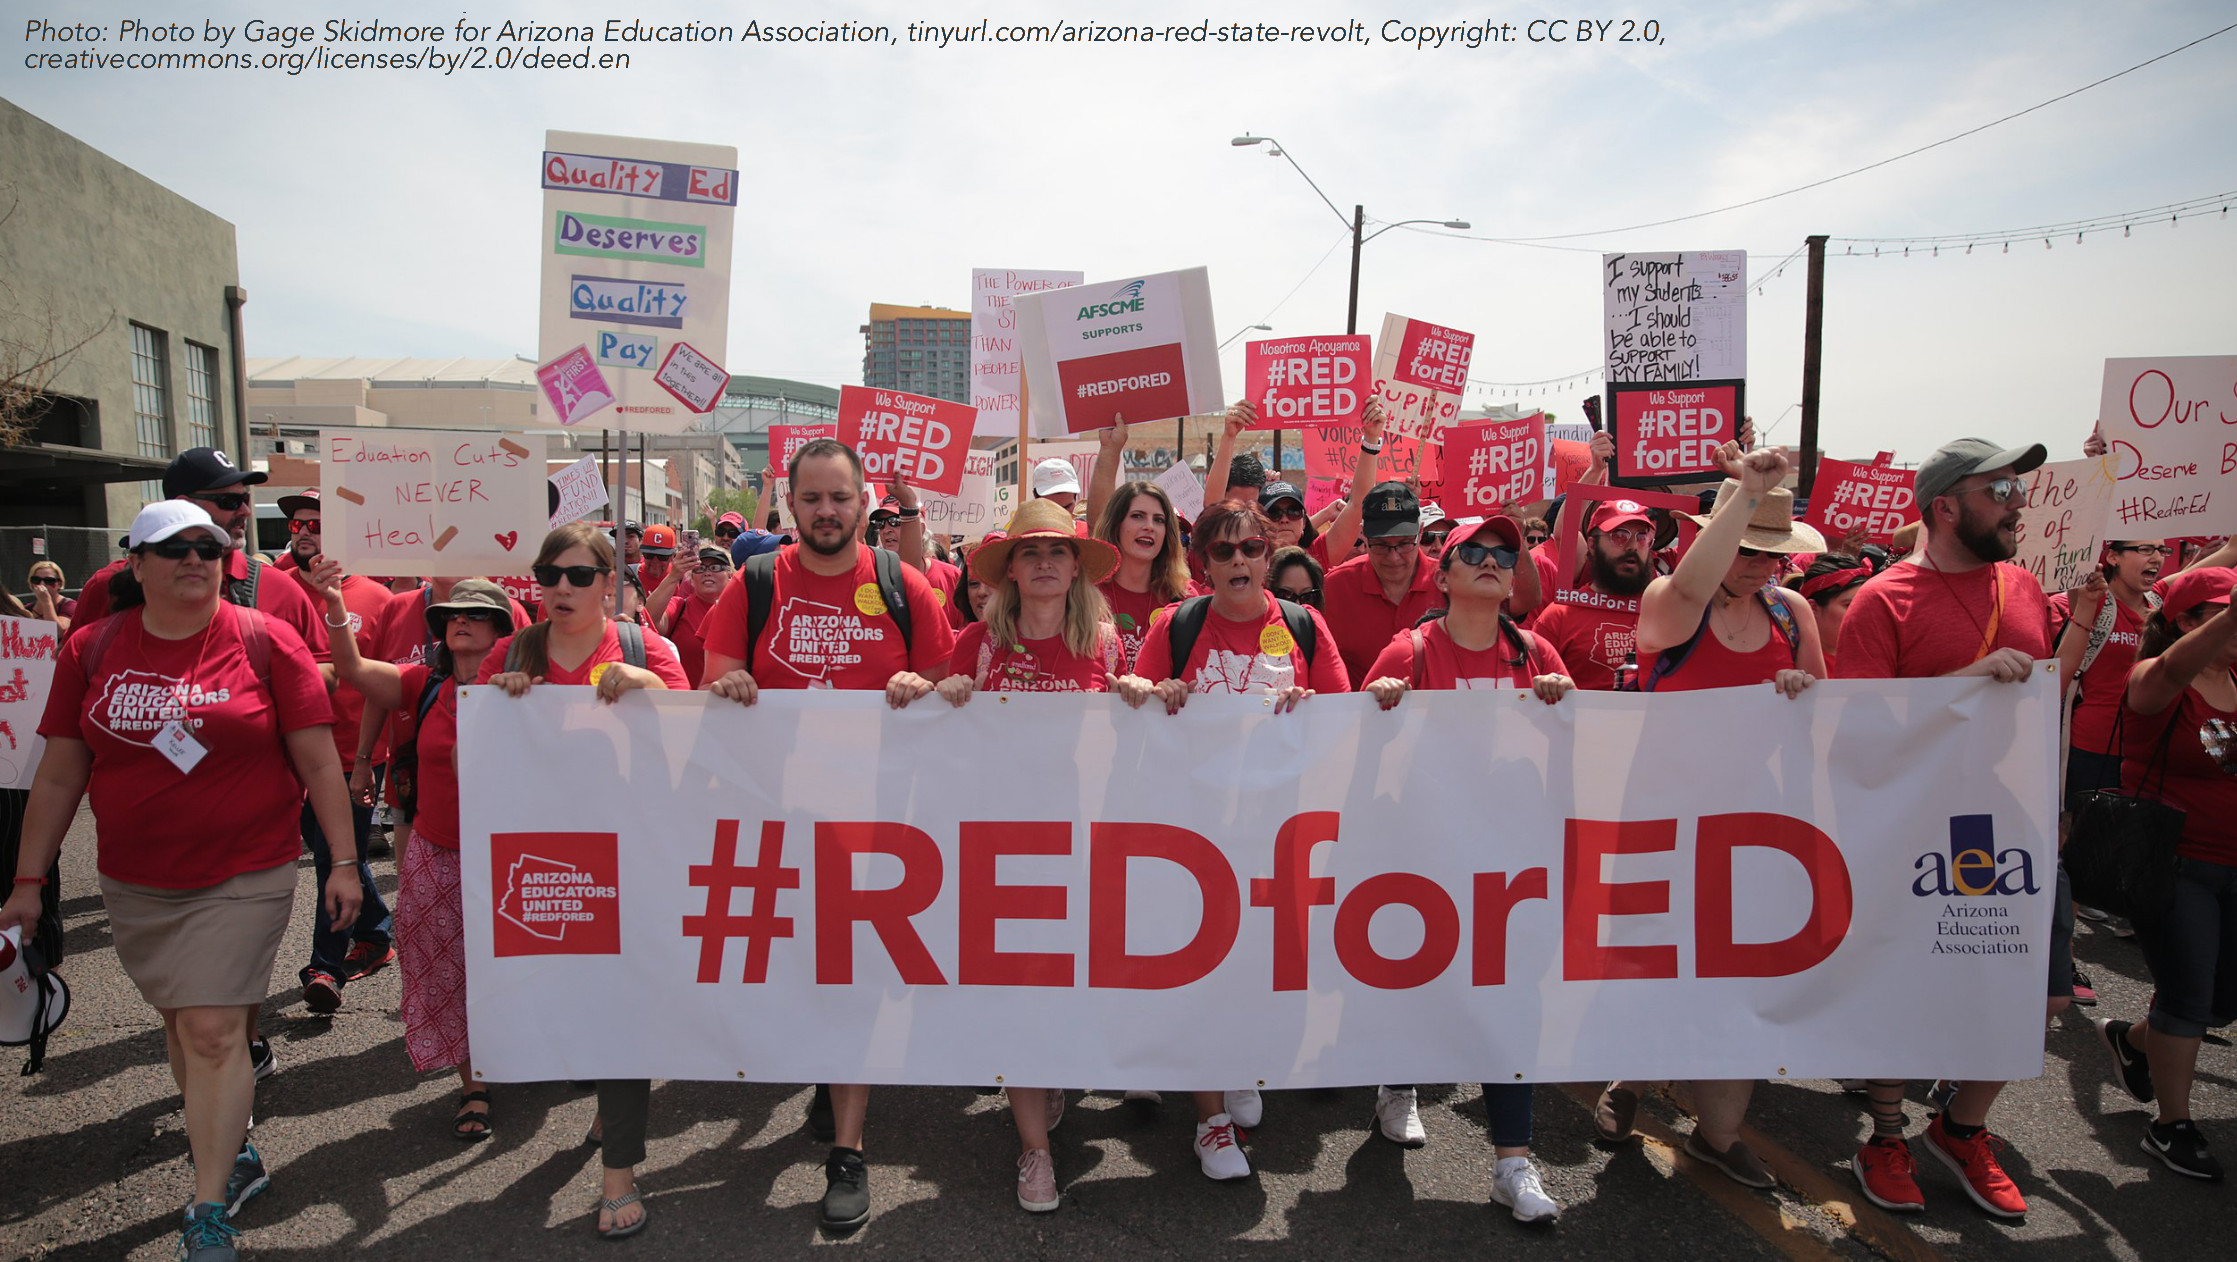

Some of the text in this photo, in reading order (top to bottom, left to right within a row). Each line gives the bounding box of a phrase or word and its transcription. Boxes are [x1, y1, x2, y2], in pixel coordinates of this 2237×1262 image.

[546, 156, 730, 201] Quality Ed
[560, 214, 698, 256] Deserves
[1608, 253, 1684, 287] I support
[572, 283, 688, 318] Quality
[1617, 284, 1640, 308] my
[1077, 298, 1145, 321] AFSCME
[1647, 306, 1691, 330] should
[971, 334, 1012, 352] THAN
[1082, 323, 1143, 340] SUPPORTS
[1431, 326, 1469, 344] We Support
[1611, 329, 1697, 349] be able to
[599, 332, 654, 367] Pay
[1260, 338, 1361, 357] Nosotros Apoyamos
[1417, 337, 1472, 367] #RED
[1609, 350, 1676, 368] SUPPORT
[974, 362, 1019, 376] PEOPLE
[1267, 356, 1357, 387] #RED
[1410, 356, 1467, 387] forED
[1613, 365, 1642, 382] MY
[1077, 371, 1172, 398] #REDFORED
[875, 392, 936, 415] We Support
[975, 394, 1020, 412] POWER
[1262, 387, 1358, 418] forED
[1649, 391, 1705, 408] We Support
[2129, 369, 2209, 429] Our
[859, 410, 951, 451] #RED
[1481, 423, 1530, 442] We Support
[1638, 408, 1724, 438] #RED
[331, 438, 519, 468] Education Cuts
[856, 440, 945, 481] forED
[1469, 437, 1538, 476] #RED
[561, 473, 599, 501] FUND
[1852, 466, 1905, 485] We Support
[395, 479, 490, 504] NEVER
[1463, 469, 1536, 507] forED
[1834, 480, 1914, 510] #RED
[1823, 503, 1905, 534] forED
[2027, 469, 2078, 549] the of
[2116, 491, 2211, 525] #RedforEd
[2054, 535, 2095, 567] fund
[2054, 564, 2077, 580] my
[1555, 588, 1638, 612] #RedForE
[790, 615, 862, 628] ARIZONA
[790, 627, 884, 641] EDUCATORS
[789, 640, 850, 654] UNITED
[788, 654, 862, 664] #REDFORED
[114, 683, 202, 697] ARIZONA
[1000, 677, 1081, 690] ARIZONA
[110, 688, 231, 708] EDUCATORS
[107, 705, 189, 720] UNITED
[521, 872, 595, 885] ARIZONA
[1911, 848, 2042, 897] aea
[521, 886, 617, 899] EDUCATORS
[682, 810, 1853, 992] #REDforED
[522, 899, 584, 912] UNITED
[1941, 903, 2009, 919] Arizona
[522, 912, 595, 923] #REDFORED
[1937, 921, 2020, 936] Education
[1931, 940, 2029, 955] Association
